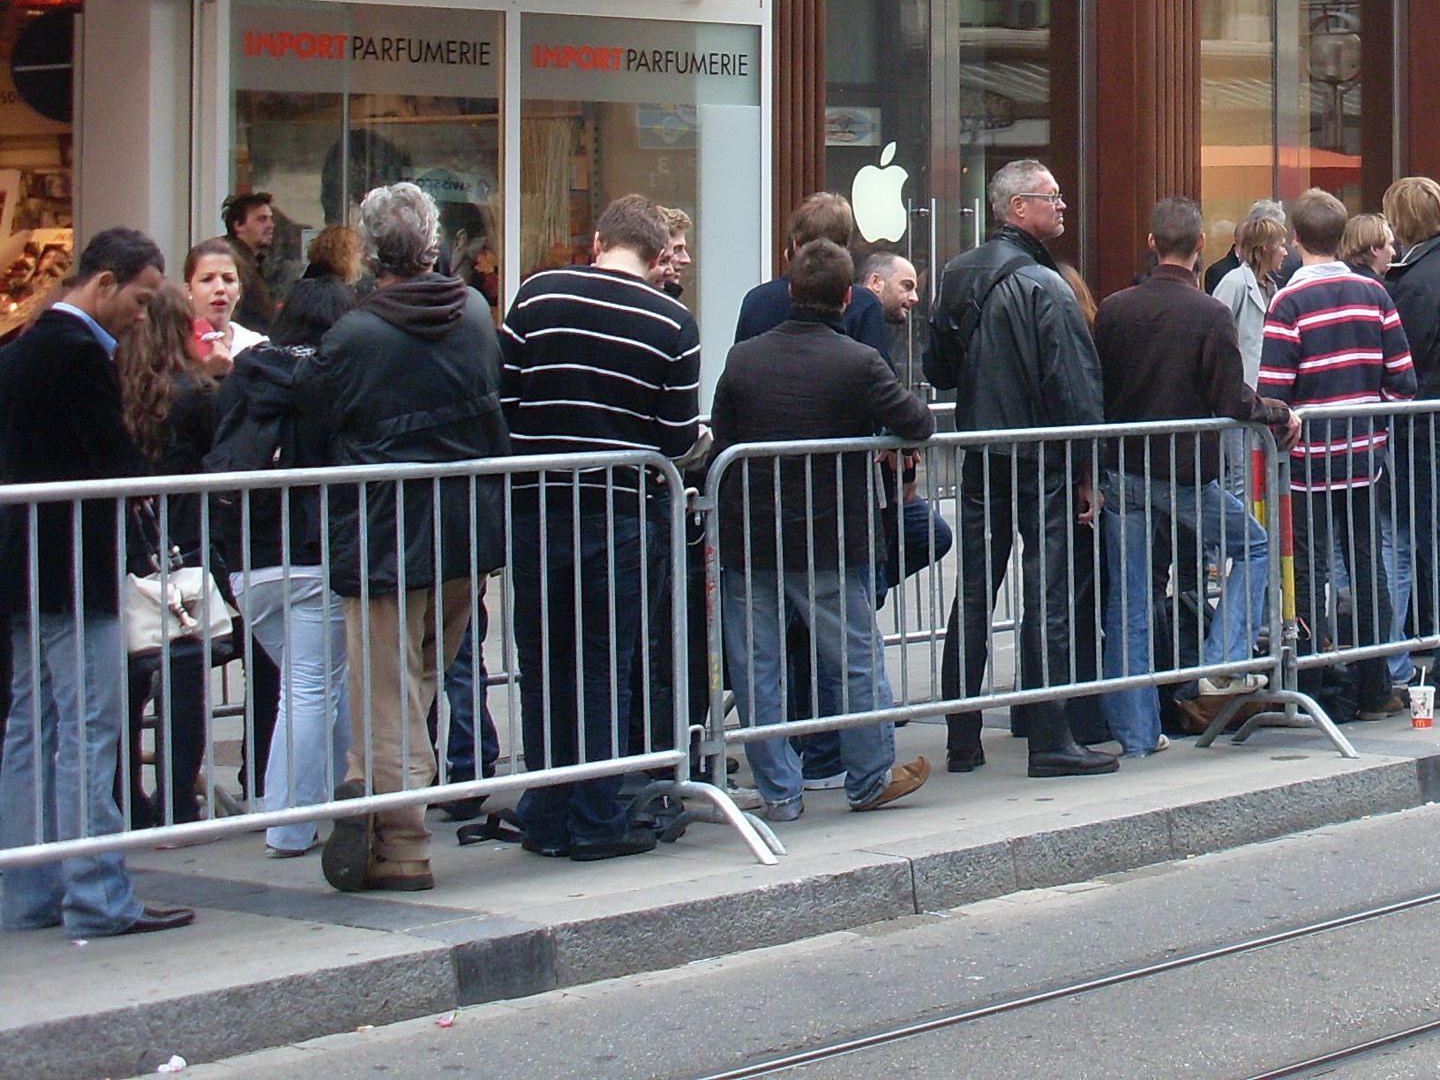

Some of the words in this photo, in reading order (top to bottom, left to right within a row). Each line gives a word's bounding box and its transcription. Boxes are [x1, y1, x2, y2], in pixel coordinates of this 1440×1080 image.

[244, 30, 348, 61] IMPORT
[352, 35, 491, 67] PARFUMERIE
[532, 44, 625, 72] IMPORT
[626, 48, 749, 77] PARFUMERIE
